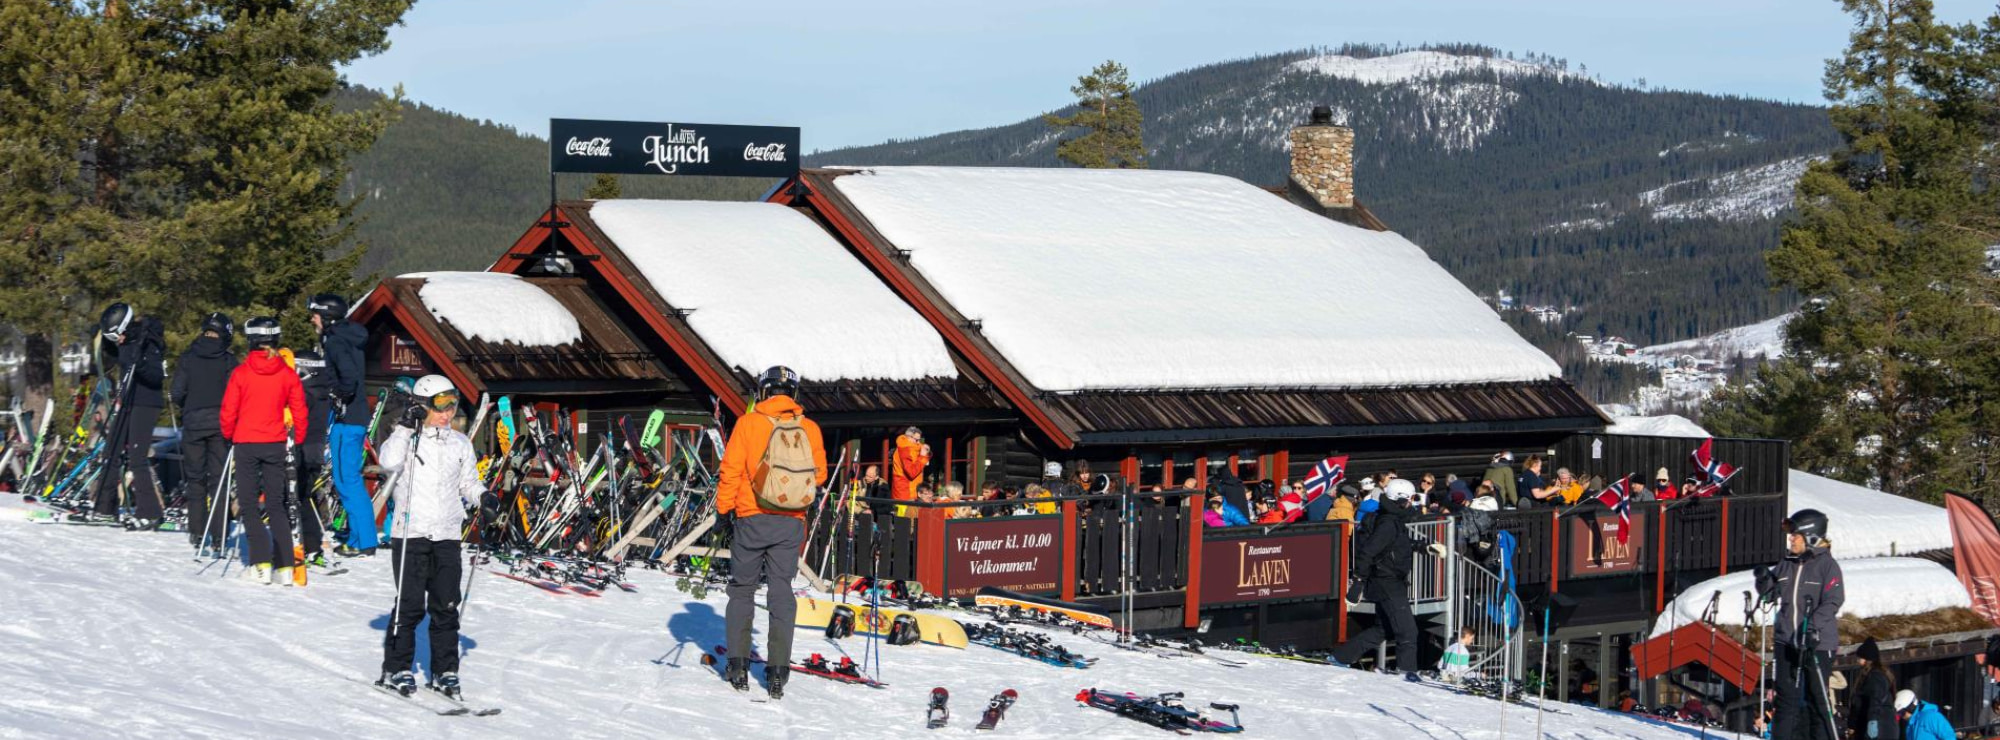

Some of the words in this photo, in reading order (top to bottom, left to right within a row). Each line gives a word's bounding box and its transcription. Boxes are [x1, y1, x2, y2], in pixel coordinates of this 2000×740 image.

[642, 135, 710, 174] Lunch
[957, 537, 969, 552] Vi
[970, 536, 1004, 554] åpner
[1005, 534, 1019, 549] kl.
[1022, 533, 1052, 548] 10.00
[970, 557, 1038, 575] Velkommen!
[1237, 541, 1291, 587] LAAVEN
